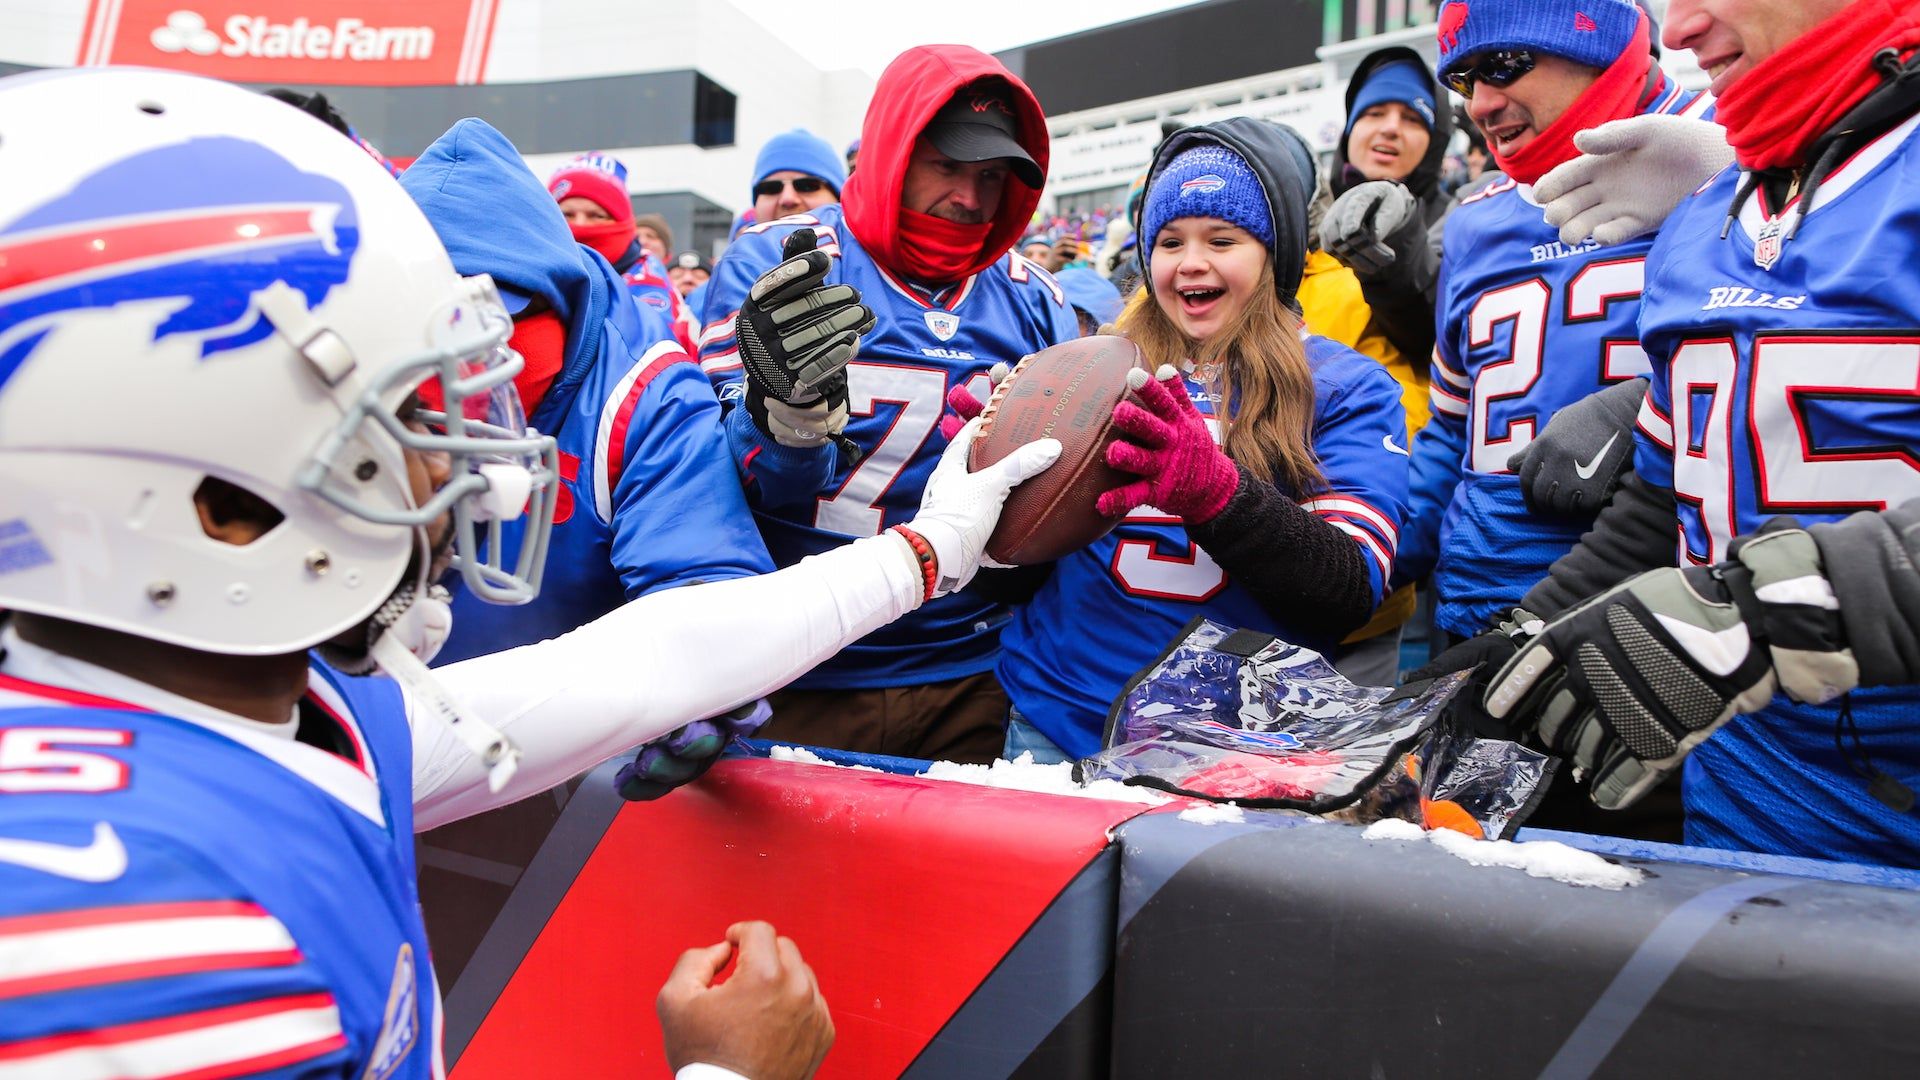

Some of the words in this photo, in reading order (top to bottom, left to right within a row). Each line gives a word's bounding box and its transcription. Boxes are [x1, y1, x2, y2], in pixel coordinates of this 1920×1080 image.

[1702, 286, 1807, 311] BILLS
[1054, 371, 1087, 417] FOOTBALL
[1669, 329, 1920, 569] 95
